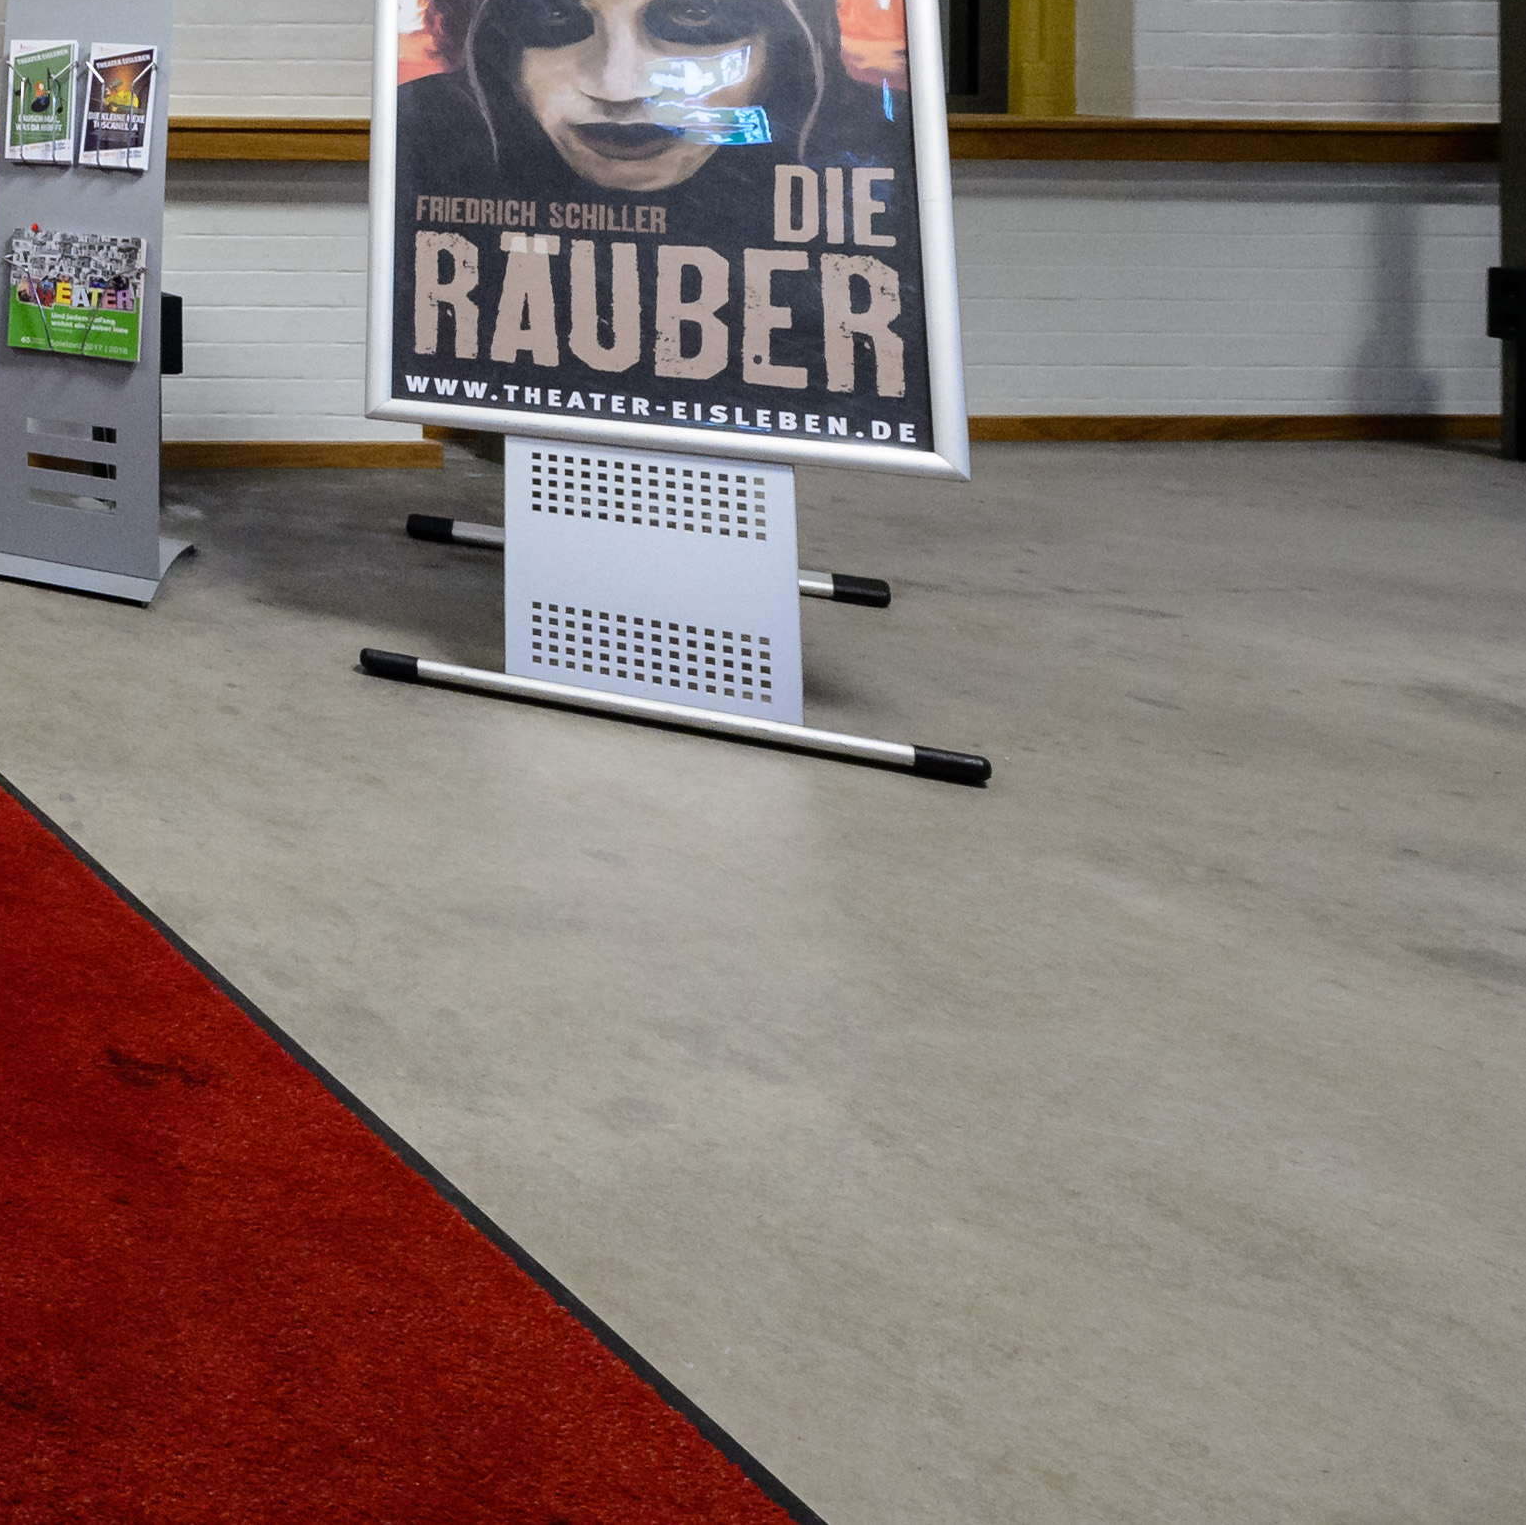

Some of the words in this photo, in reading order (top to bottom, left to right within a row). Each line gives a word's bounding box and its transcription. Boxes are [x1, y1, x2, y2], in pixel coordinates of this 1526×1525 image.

[415, 194, 536, 228] FRIEDRICH
[549, 201, 668, 234] SCHILLER
[773, 164, 897, 248] DIE
[413, 230, 906, 398] RÄUBER
[406, 375, 917, 443] WWW.THEATER-EISLEBEN.DE
